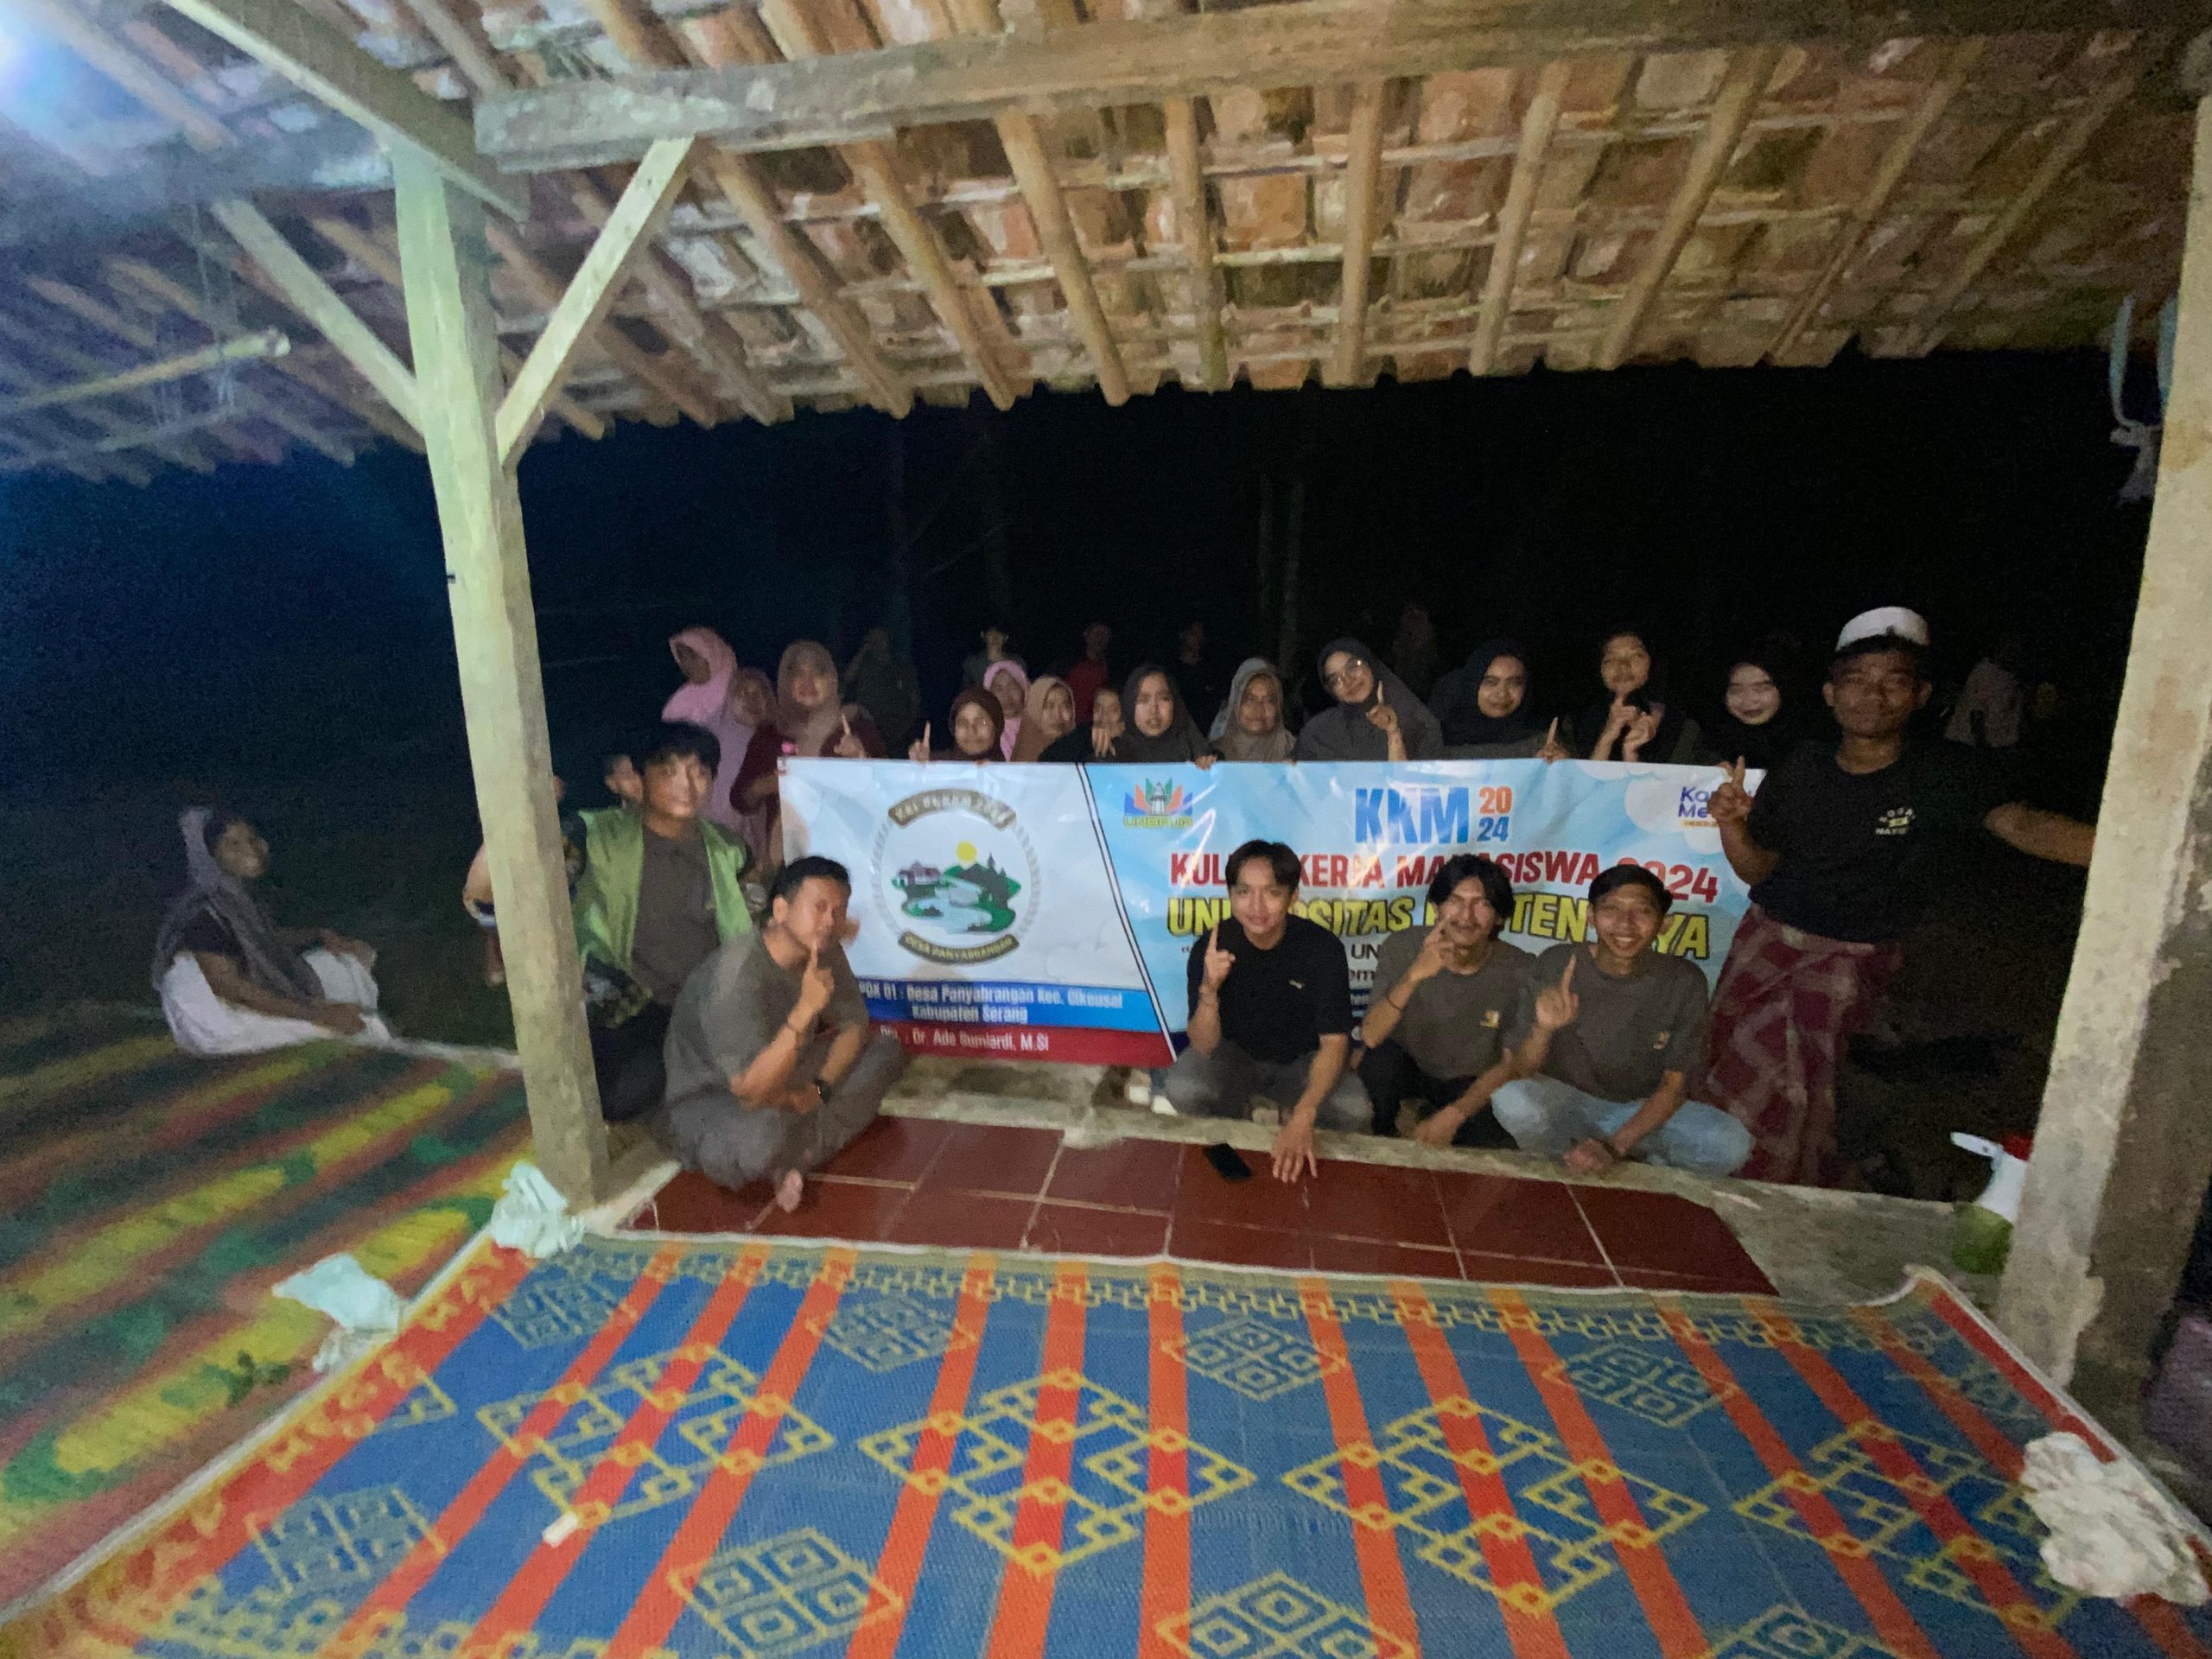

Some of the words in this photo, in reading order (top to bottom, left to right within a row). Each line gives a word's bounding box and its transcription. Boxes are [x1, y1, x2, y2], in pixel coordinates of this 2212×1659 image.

[1479, 786, 1512, 815] 20
[1355, 787, 1469, 844] KKM
[1477, 817, 1510, 842] 24
[1396, 850, 1600, 888] MASISWA
[1617, 856, 1719, 904] 024
[1167, 896, 1414, 938] UNISITAS
[907, 984, 938, 1003] Desa
[912, 1004, 979, 1022] Kabupaten
[982, 1004, 1028, 1024] Serang
